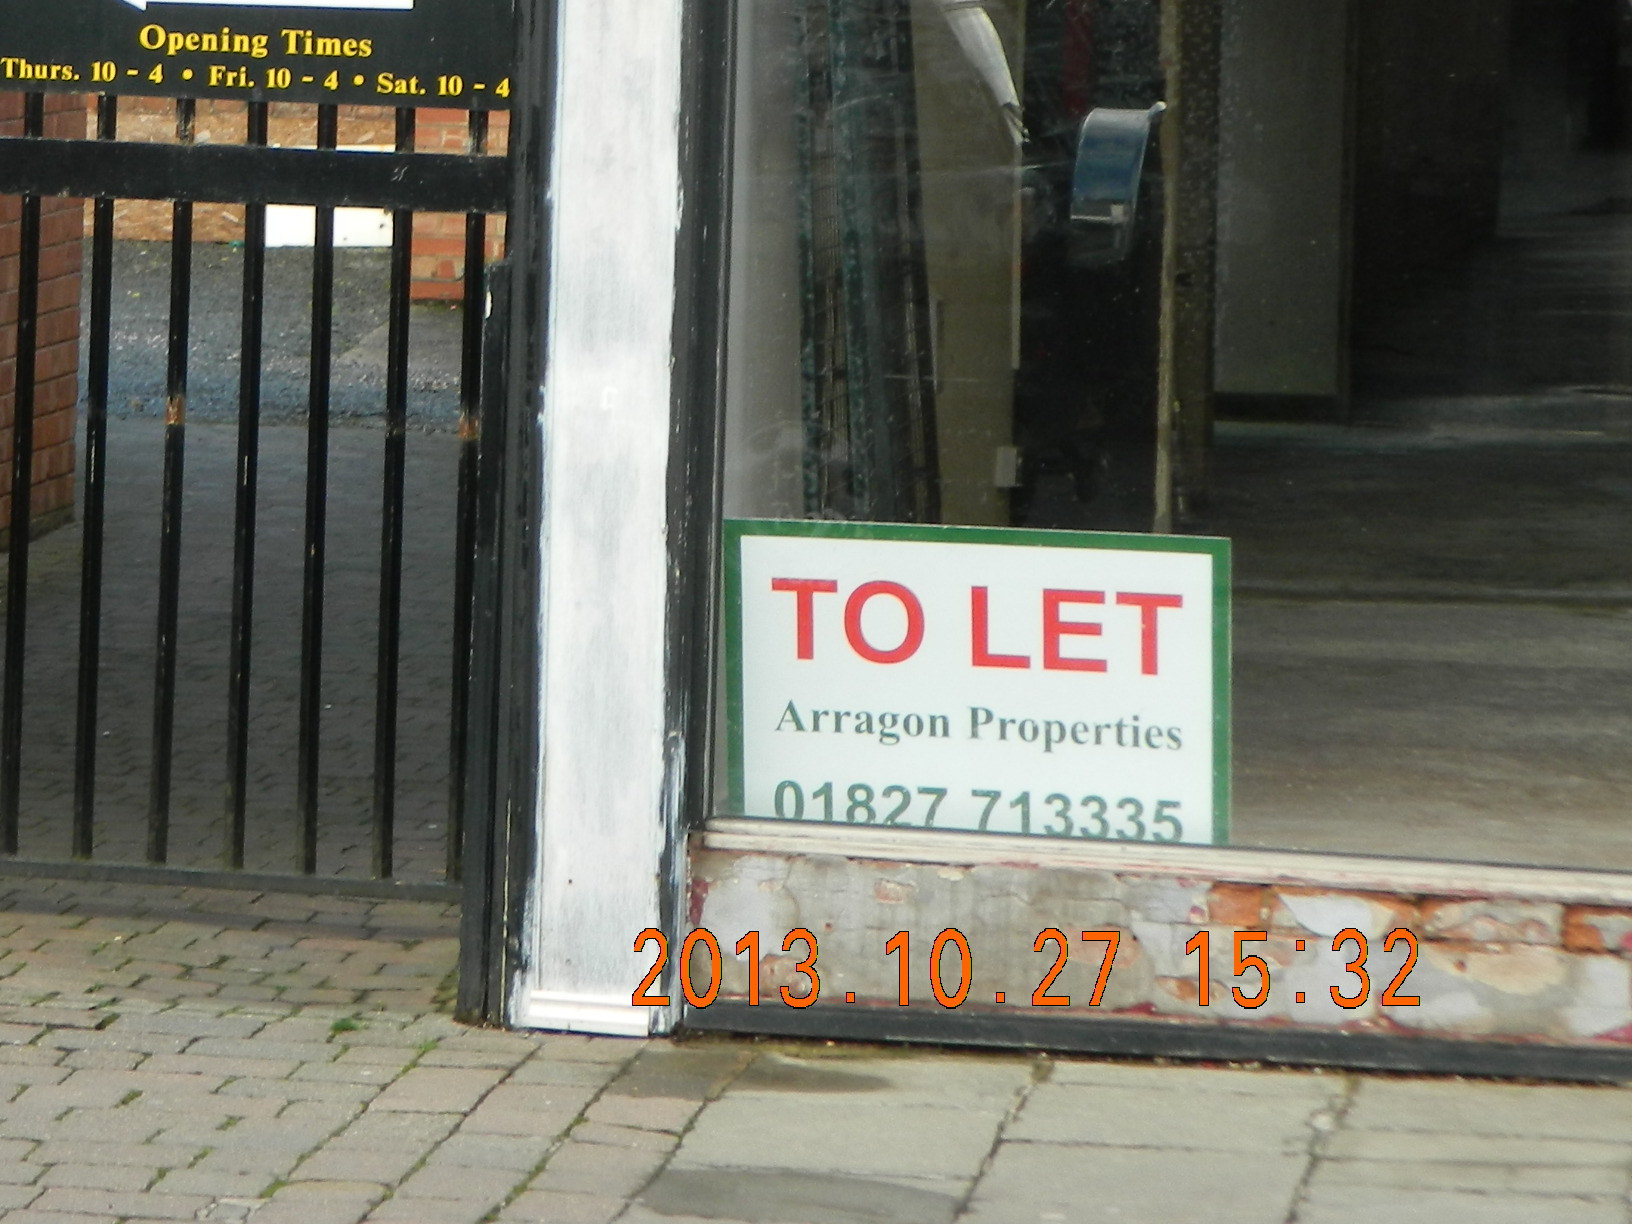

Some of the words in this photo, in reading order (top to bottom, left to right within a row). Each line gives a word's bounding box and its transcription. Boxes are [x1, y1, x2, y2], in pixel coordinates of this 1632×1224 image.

[138, 23, 269, 59] Opening
[280, 29, 373, 58] Times
[0, 57, 80, 81] Thurs.
[91, 61, 117, 83] 10
[147, 63, 164, 84] 4
[208, 65, 255, 88] Fri.
[265, 68, 292, 89] 10
[322, 70, 339, 91] 4
[376, 72, 426, 96] Sat.
[437, 75, 464, 97] 10
[494, 77, 511, 99] 4
[771, 579, 924, 665] TO
[971, 587, 1182, 676] LET
[776, 700, 949, 743] Arragon
[971, 707, 1180, 752] Properties
[774, 780, 948, 828] 01827
[971, 789, 1183, 843] 713335
